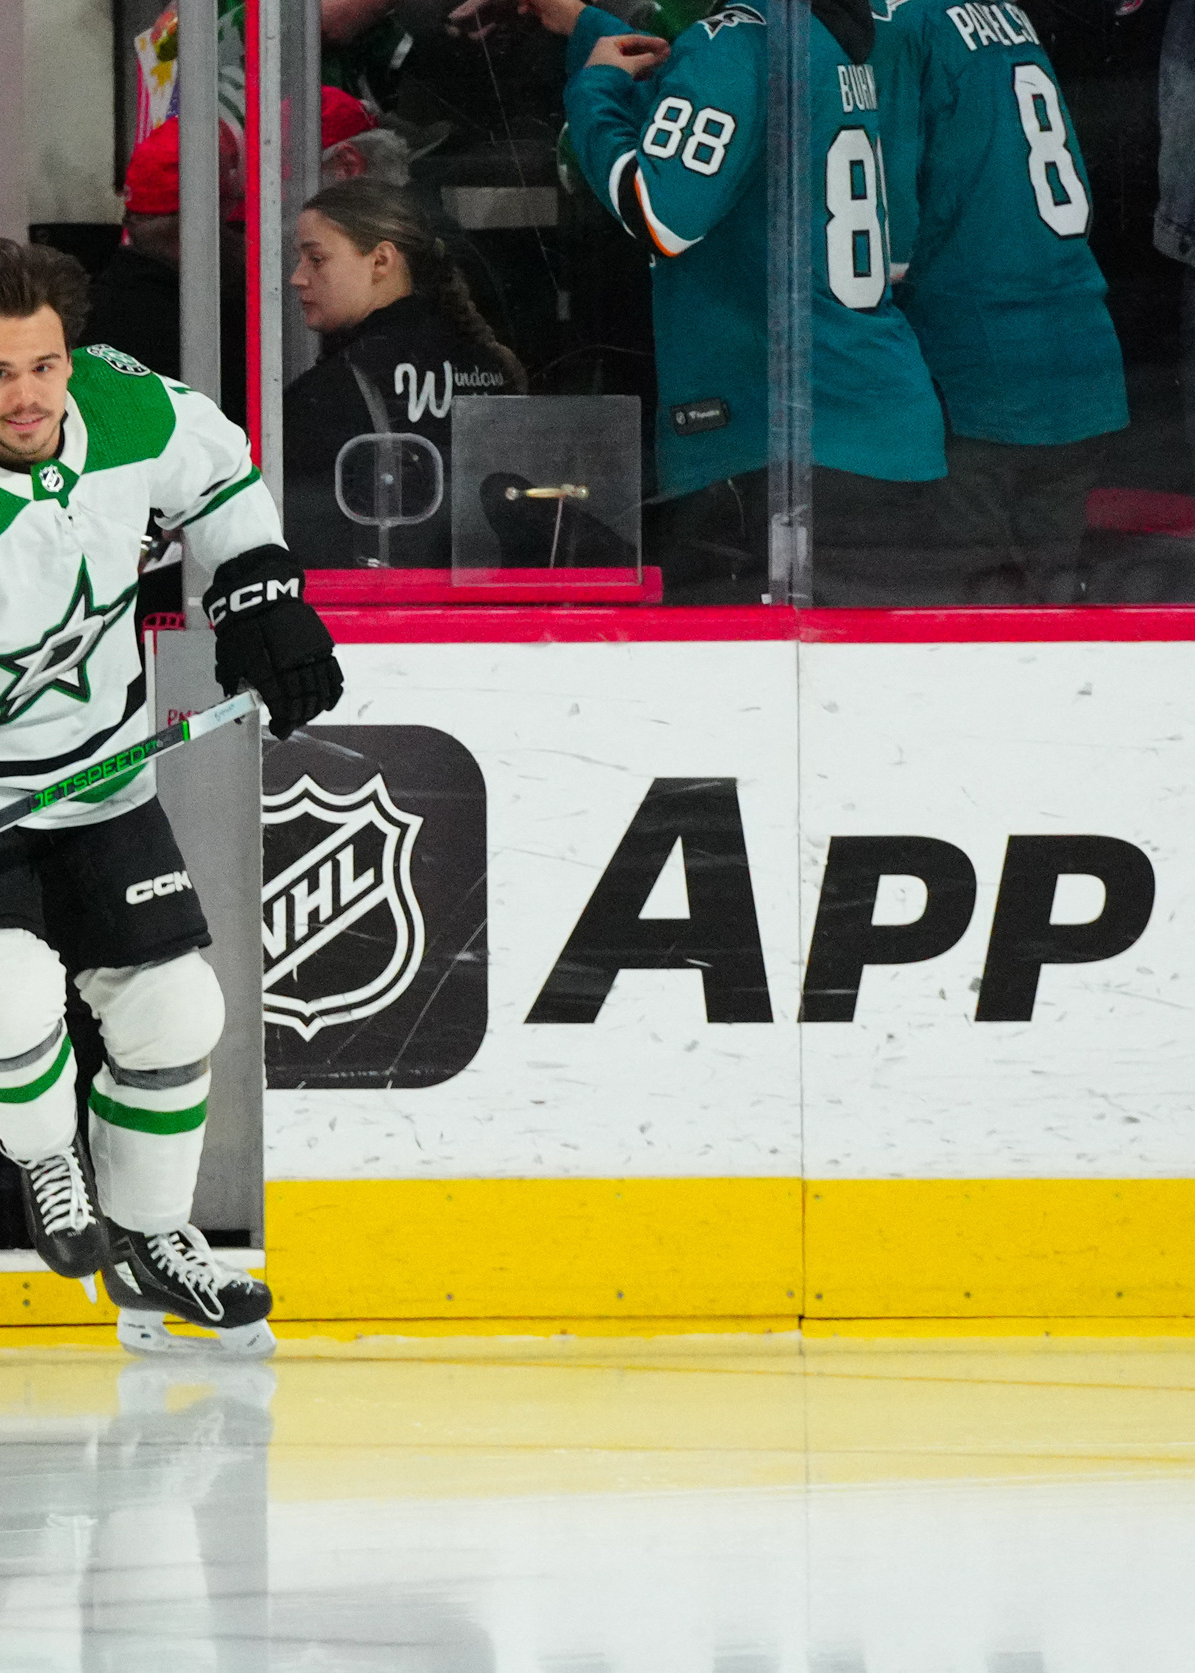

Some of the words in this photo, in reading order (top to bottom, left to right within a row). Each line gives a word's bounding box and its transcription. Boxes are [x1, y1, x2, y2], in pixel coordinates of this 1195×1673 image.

[642, 96, 736, 176] 88
[825, 125, 891, 312] 8
[208, 577, 300, 626] CCM
[31, 746, 145, 813] JETSPEED
[125, 869, 193, 905] CCM
